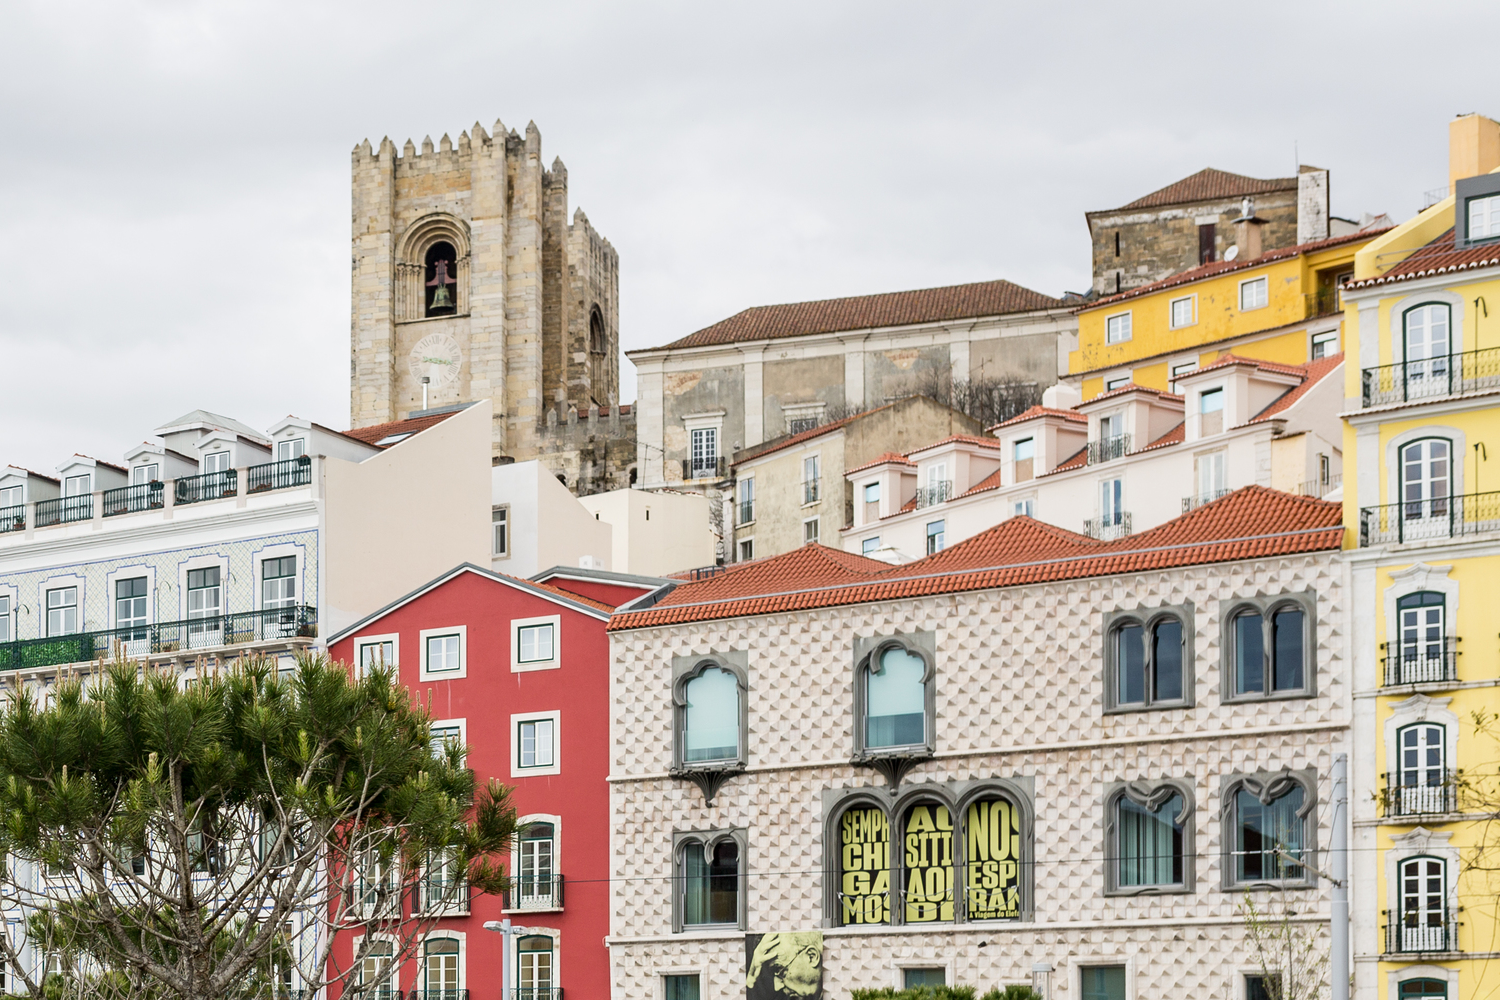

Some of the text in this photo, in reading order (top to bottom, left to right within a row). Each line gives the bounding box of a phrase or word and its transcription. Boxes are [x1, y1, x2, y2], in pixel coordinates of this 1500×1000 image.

[842, 809, 890, 844] SEMPR
[905, 831, 955, 868] SÍTI
[968, 860, 1019, 889] ESP
